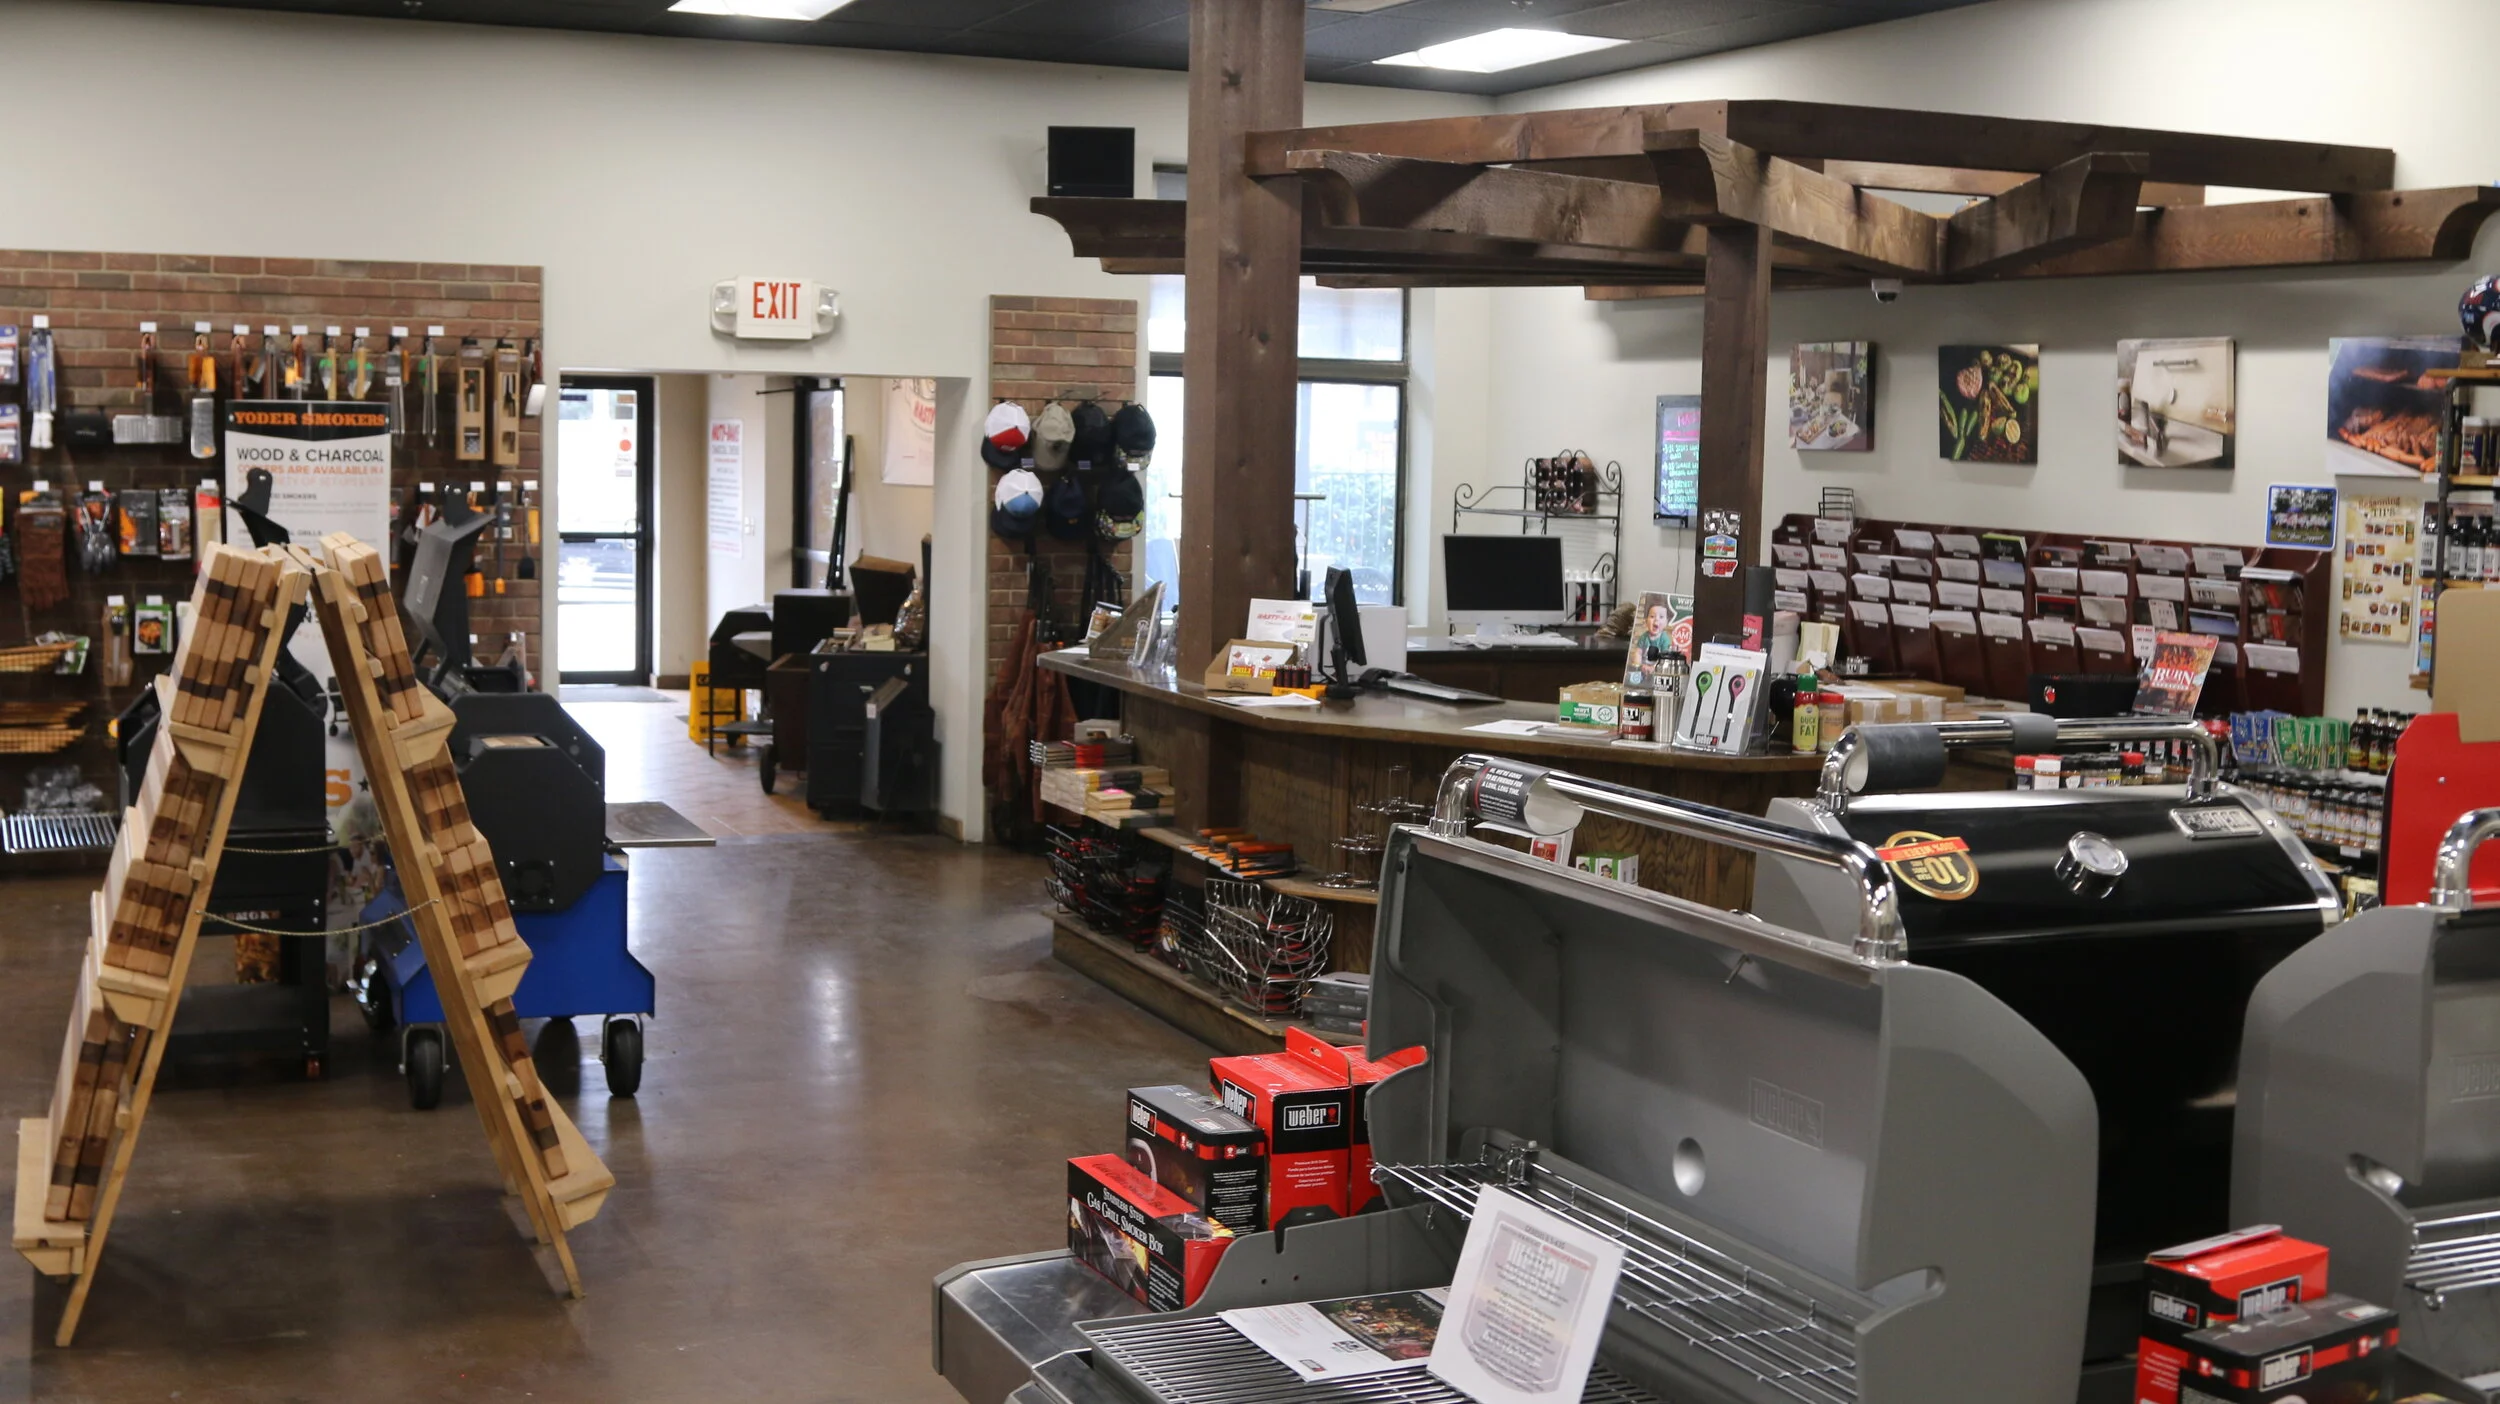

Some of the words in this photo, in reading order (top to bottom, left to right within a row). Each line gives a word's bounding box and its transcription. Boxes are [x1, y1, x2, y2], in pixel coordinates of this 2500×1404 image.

[753, 281, 801, 320] EXIT
[234, 411, 298, 425] YODER
[301, 412, 386, 427] SMOKERS
[236, 448, 284, 461] WOOD
[289, 448, 300, 462] &
[305, 449, 384, 463] CHARCOAL
[287, 465, 310, 475] ARE
[313, 466, 367, 475] AVAILABLE
[2153, 667, 2195, 687] BURN
[1800, 715, 1817, 724] DUCK
[1800, 724, 1817, 737] FAT
[1496, 776, 1514, 786] FRIENDS
[1513, 780, 1524, 788] FOR
[1497, 785, 1509, 793] LONG
[1923, 856, 1967, 885] 10
[1224, 1082, 1247, 1118] weber
[1131, 1105, 1150, 1129] weber
[1288, 1105, 1327, 1127] weber
[1102, 1187, 1129, 1214] STAINLESS
[1128, 1205, 1146, 1225] STEEL
[1087, 1191, 1101, 1211] GAS
[1101, 1202, 1121, 1226] GRILL
[1120, 1215, 1148, 1245] SMOKER
[1148, 1232, 1164, 1256] BOX
[2152, 1295, 2187, 1320] weber
[2263, 1354, 2300, 1387] weber
